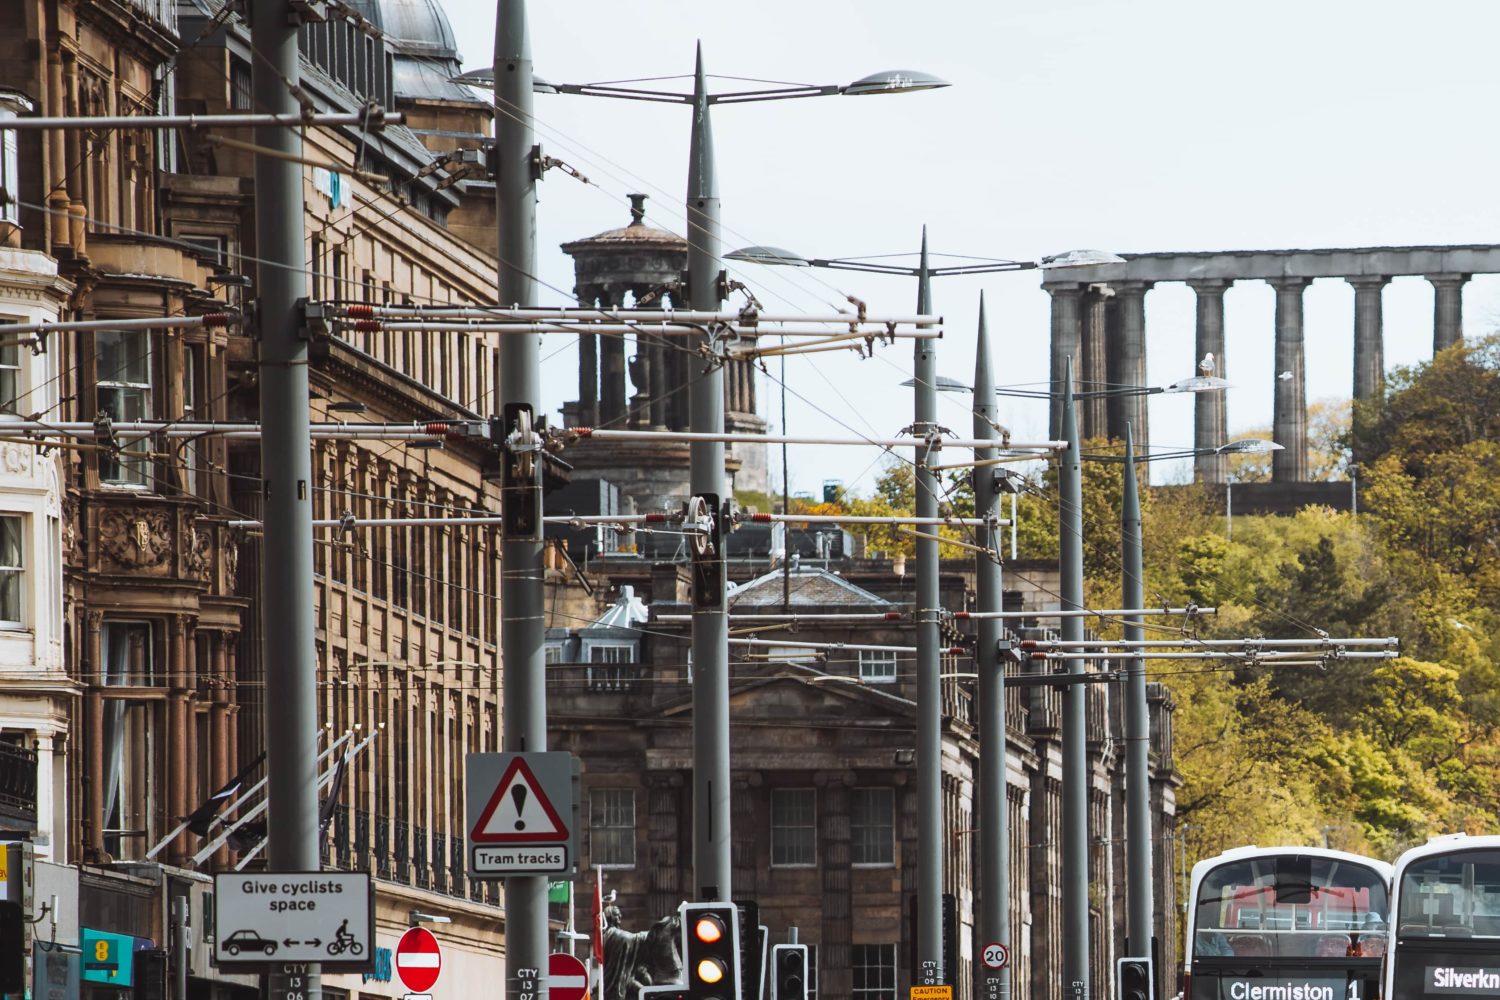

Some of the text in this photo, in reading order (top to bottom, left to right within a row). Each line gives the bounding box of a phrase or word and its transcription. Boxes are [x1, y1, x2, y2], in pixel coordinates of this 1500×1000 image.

[479, 853, 561, 865] Tram tracks
[242, 880, 343, 896] Give cyclists
[269, 900, 316, 913] space
[985, 951, 1004, 962] 20
[284, 964, 307, 974] CTY
[517, 968, 538, 978] CTY
[925, 969, 934, 977] 13
[289, 977, 301, 988] 13
[522, 980, 533, 990] 13
[986, 977, 1000, 985] CTY
[1230, 981, 1333, 1000] Clermiston
